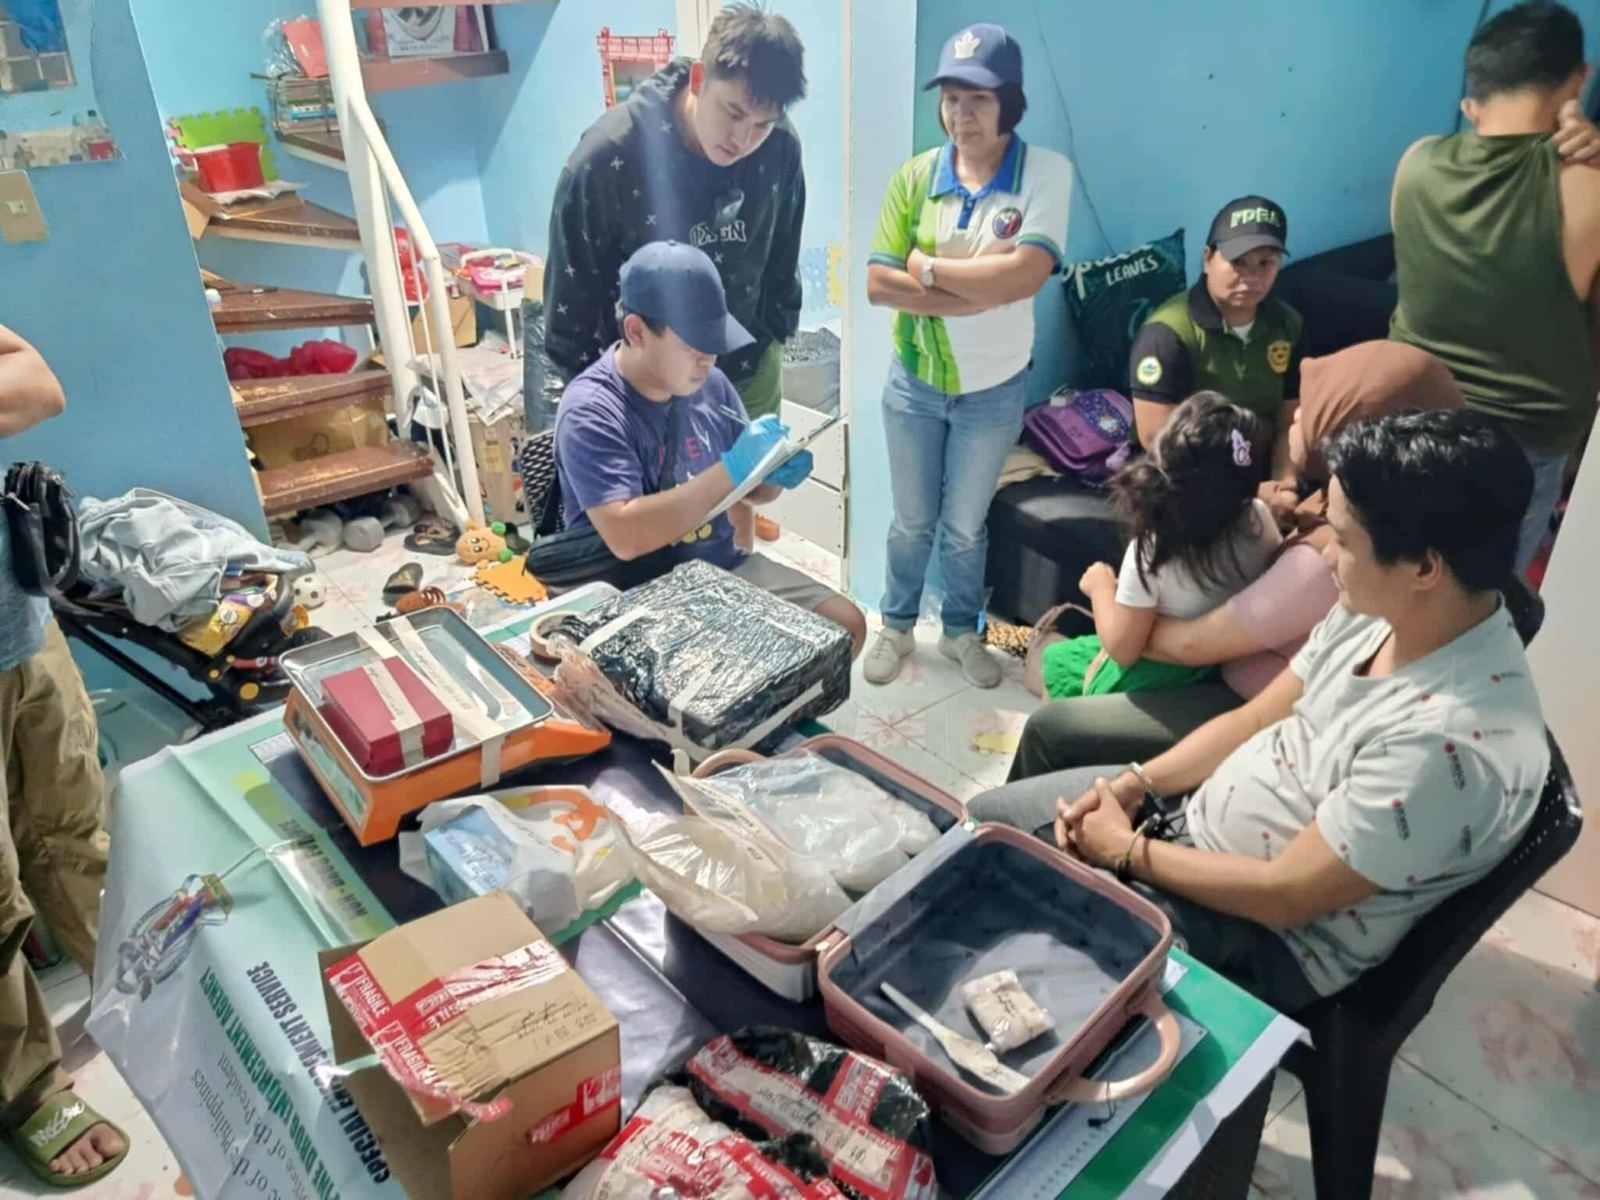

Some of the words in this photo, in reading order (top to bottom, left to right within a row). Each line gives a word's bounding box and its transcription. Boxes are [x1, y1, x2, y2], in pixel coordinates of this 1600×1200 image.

[1106, 256, 1159, 286] LEAVES
[199, 966, 235, 1026] AGENCY
[246, 961, 296, 1019] SERVICE
[355, 976, 390, 1019] FRAGILE
[394, 1036, 427, 1080] FRAGIL
[188, 1070, 236, 1153] Philippines
[217, 1053, 256, 1124] President
[266, 1137, 286, 1159] of
[288, 1112, 317, 1172] DRUG
[338, 1107, 392, 1184] SPECIAL
[245, 1168, 269, 1192] of
